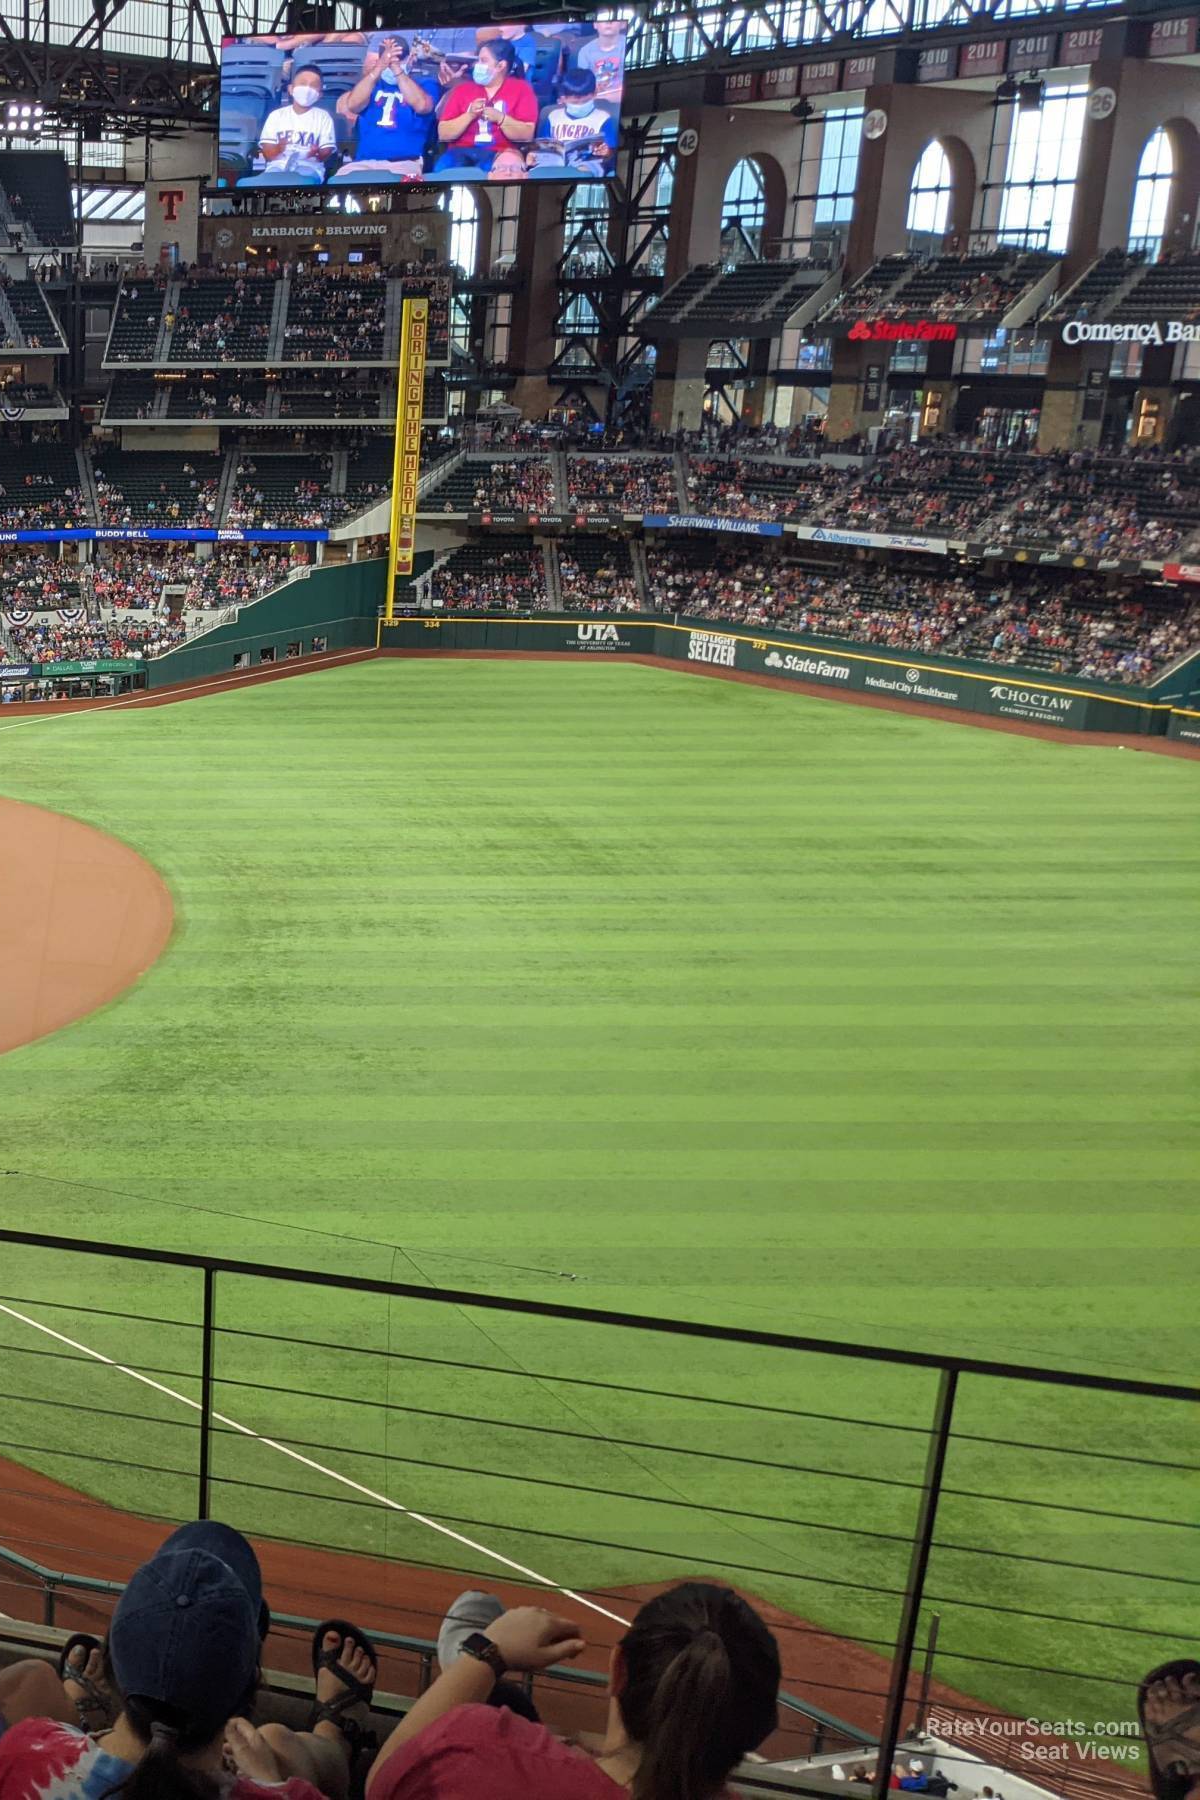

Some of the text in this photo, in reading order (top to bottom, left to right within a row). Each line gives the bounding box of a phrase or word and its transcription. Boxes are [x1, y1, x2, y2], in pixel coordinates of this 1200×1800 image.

[1153, 20, 1189, 38] 2015
[1017, 36, 1048, 54] 2011
[1069, 29, 1103, 48] 2012
[920, 49, 949, 66] 2010
[968, 43, 997, 59] 2011
[1090, 93, 1112, 112] 26
[870, 116, 884, 131] 34
[680, 134, 696, 150] 42
[159, 190, 184, 221] T
[252, 224, 387, 237] KARBACH BREWING
[408, 324, 424, 400] BRING
[405, 405, 420, 450] THE
[402, 455, 418, 515] HEAT
[96, 530, 148, 538] BUDDY BELL
[827, 531, 871, 546] Albertsons
[424, 620, 440, 628] 334
[577, 624, 619, 640] UTA
[690, 632, 736, 646] BUD LIGHT
[752, 641, 768, 650] 372
[688, 641, 736, 667] SELTZER
[865, 676, 958, 700] Medical City Healthcare
[998, 686, 1073, 711] CHOCTAW
